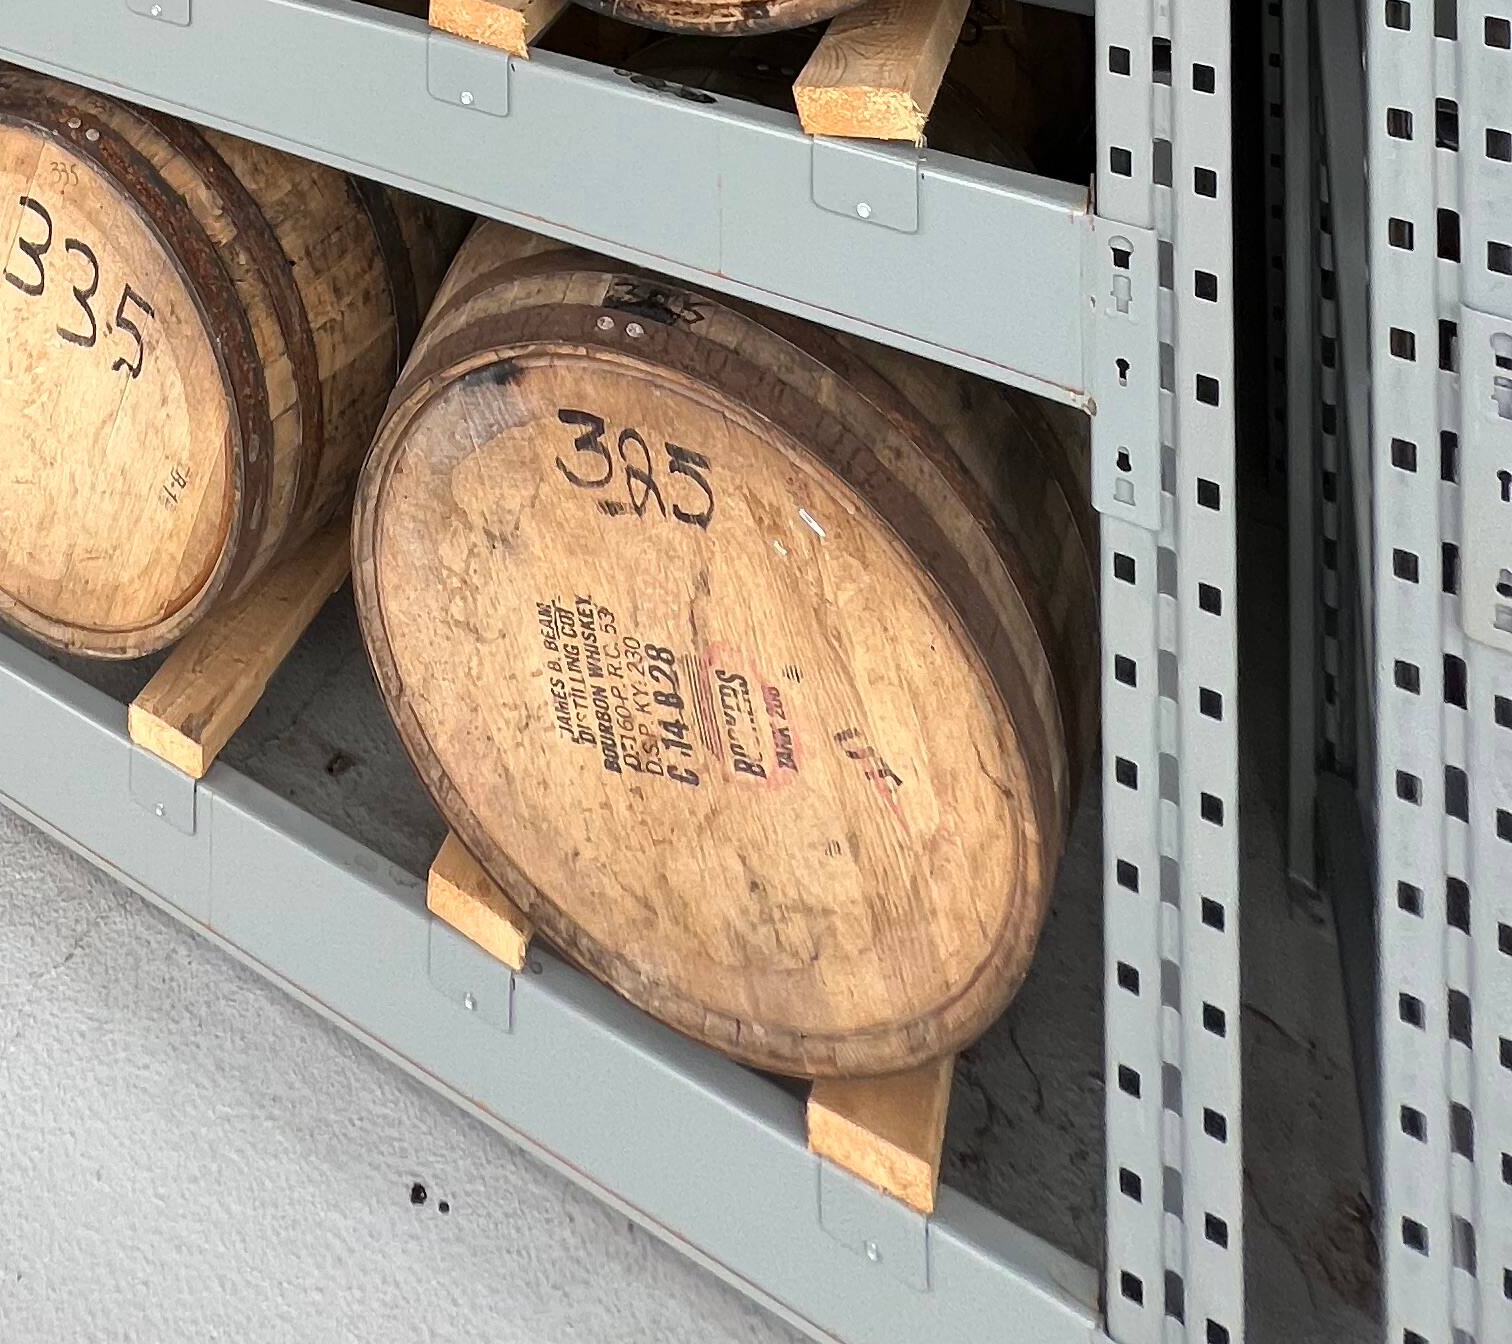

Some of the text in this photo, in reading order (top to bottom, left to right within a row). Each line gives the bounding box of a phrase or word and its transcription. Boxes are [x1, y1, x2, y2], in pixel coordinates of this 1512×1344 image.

[50, 160, 79, 187] 335
[3, 195, 157, 379] 335
[555, 408, 714, 532] 325
[536, 601, 559, 652] BEAM
[597, 606, 617, 635] 53
[622, 635, 646, 677] 230
[550, 676, 575, 738] JAMES
[591, 684, 623, 775] BOURBON
[666, 764, 701, 787] C
